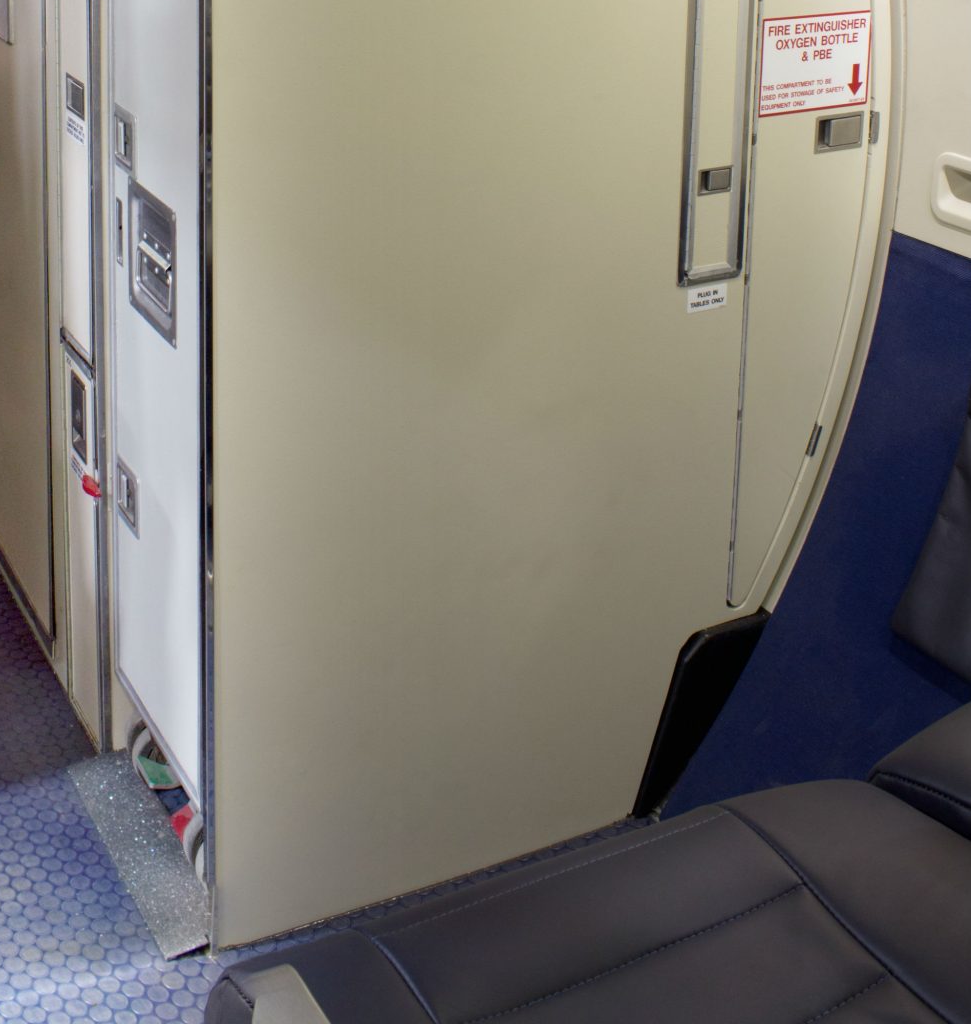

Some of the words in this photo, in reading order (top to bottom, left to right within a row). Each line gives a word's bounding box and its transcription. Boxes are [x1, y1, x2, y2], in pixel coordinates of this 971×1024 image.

[768, 25, 790, 36] FIRE
[795, 19, 866, 34] EXTINGUISHER
[776, 37, 817, 50] OXYGEN
[821, 33, 859, 46] BOTTLE
[802, 52, 808, 61] &
[813, 49, 832, 60] PBE
[776, 80, 815, 90] COMPARTMENT
[791, 90, 815, 98] STOWAGE
[826, 86, 844, 94] SAFETY
[761, 102, 791, 111] EQUIPMENT
